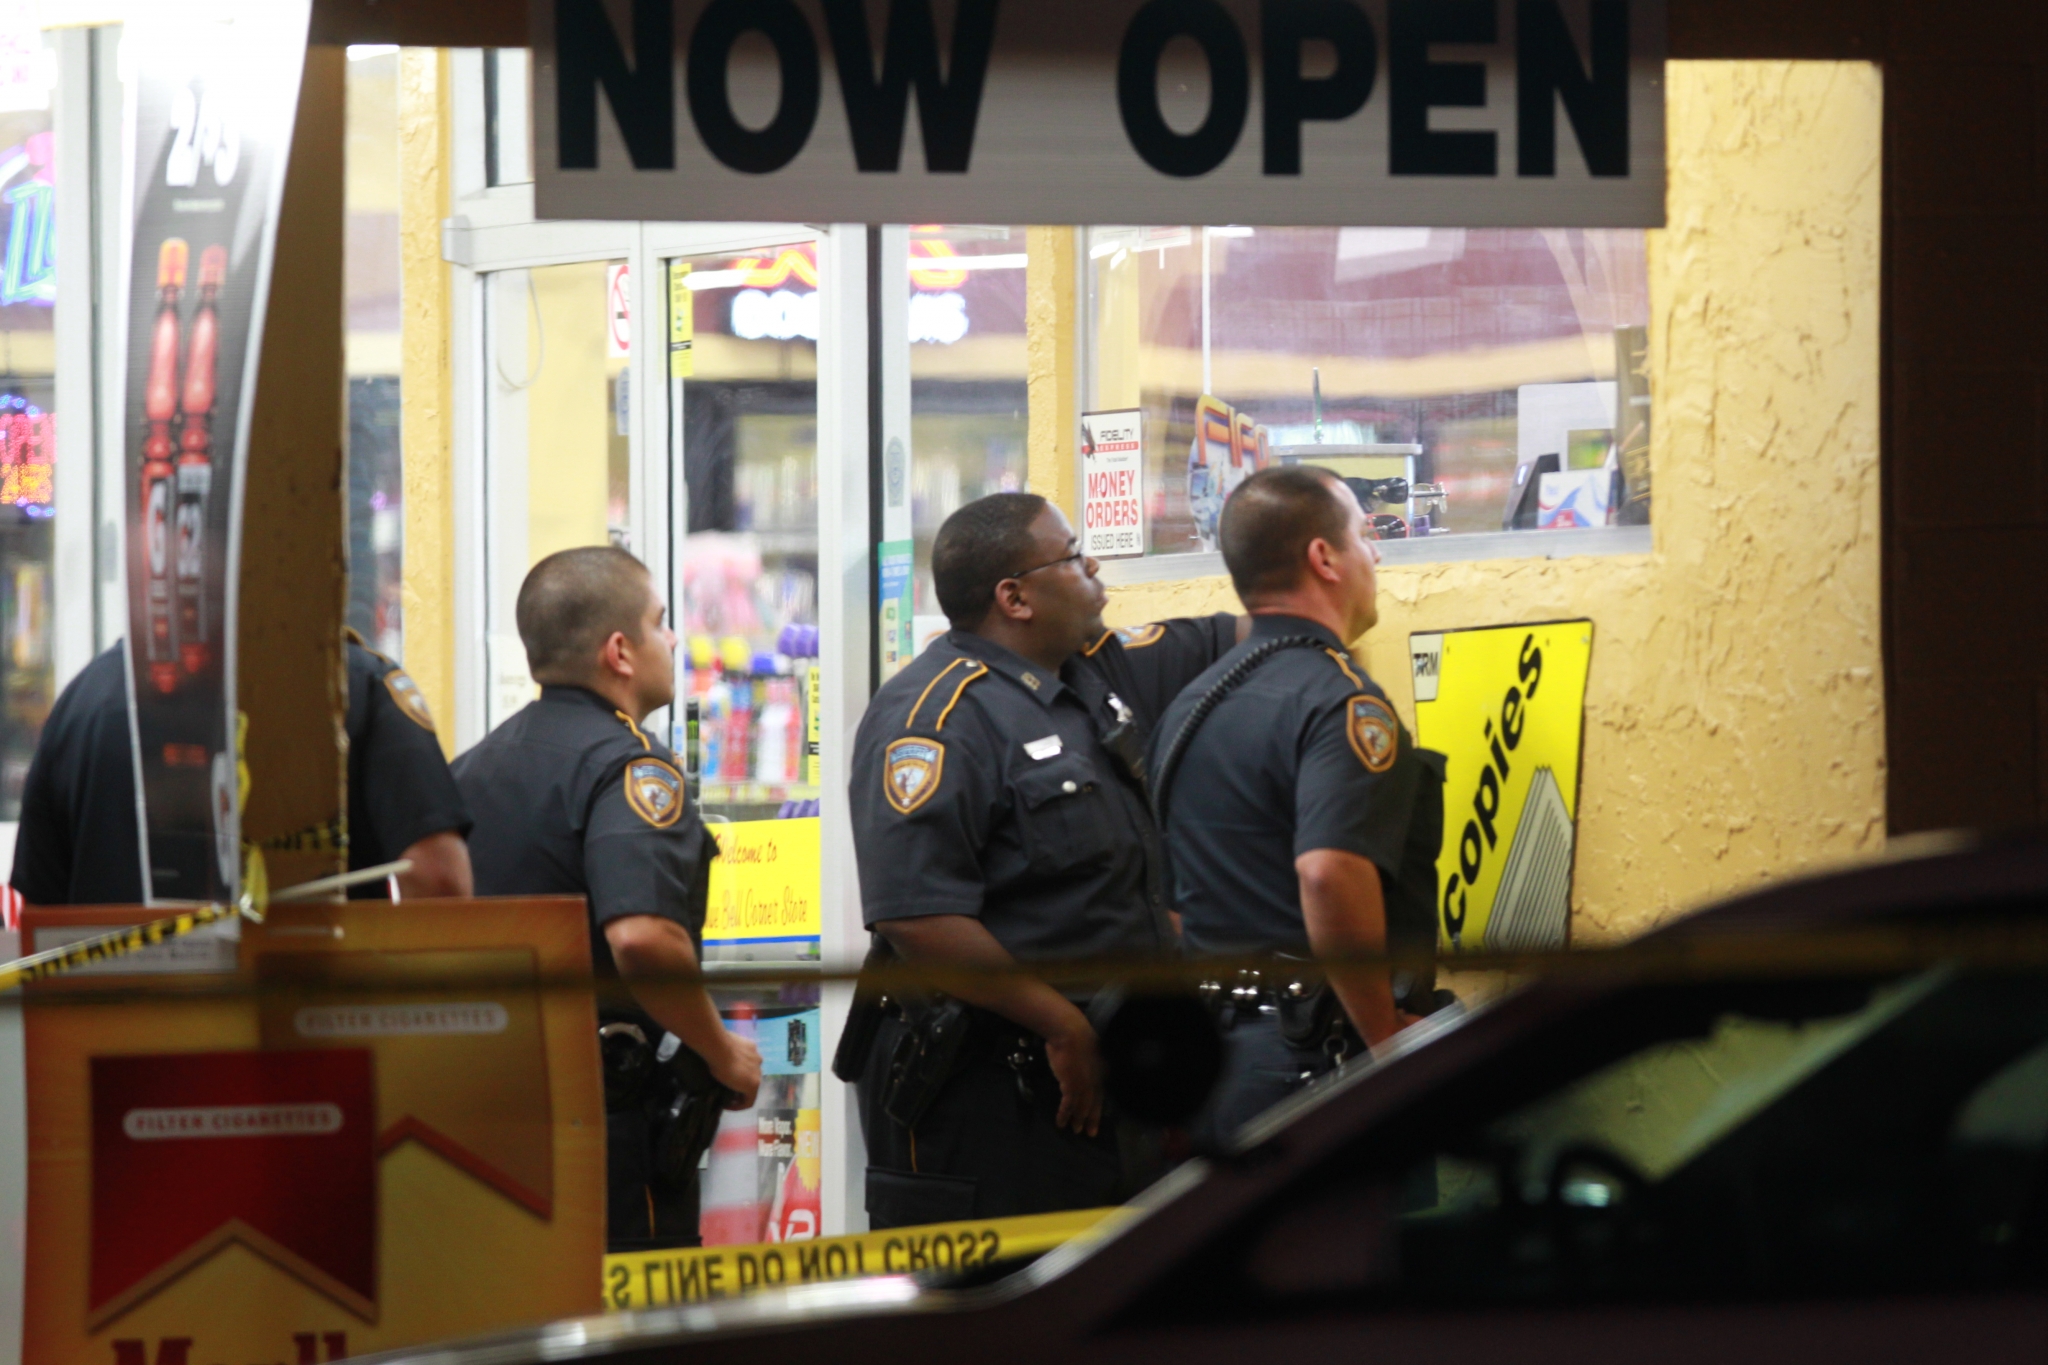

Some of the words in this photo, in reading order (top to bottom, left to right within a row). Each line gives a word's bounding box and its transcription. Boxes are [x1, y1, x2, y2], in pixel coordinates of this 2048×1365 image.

[554, 0, 997, 174] NOW
[1117, 0, 1630, 177] OPEN
[1100, 428, 1134, 441] FIDELITY
[1088, 470, 1135, 499] MONEY
[1086, 499, 1138, 529] ORDERS
[1091, 534, 1114, 550] ISSUED
[1116, 532, 1134, 549] HERE
[1444, 633, 1542, 942] copies
[745, 888, 779, 929] Corner
[781, 885, 808, 927] Store
[135, 1112, 204, 1132] FILTER
[211, 1110, 332, 1131] CIGARETTES
